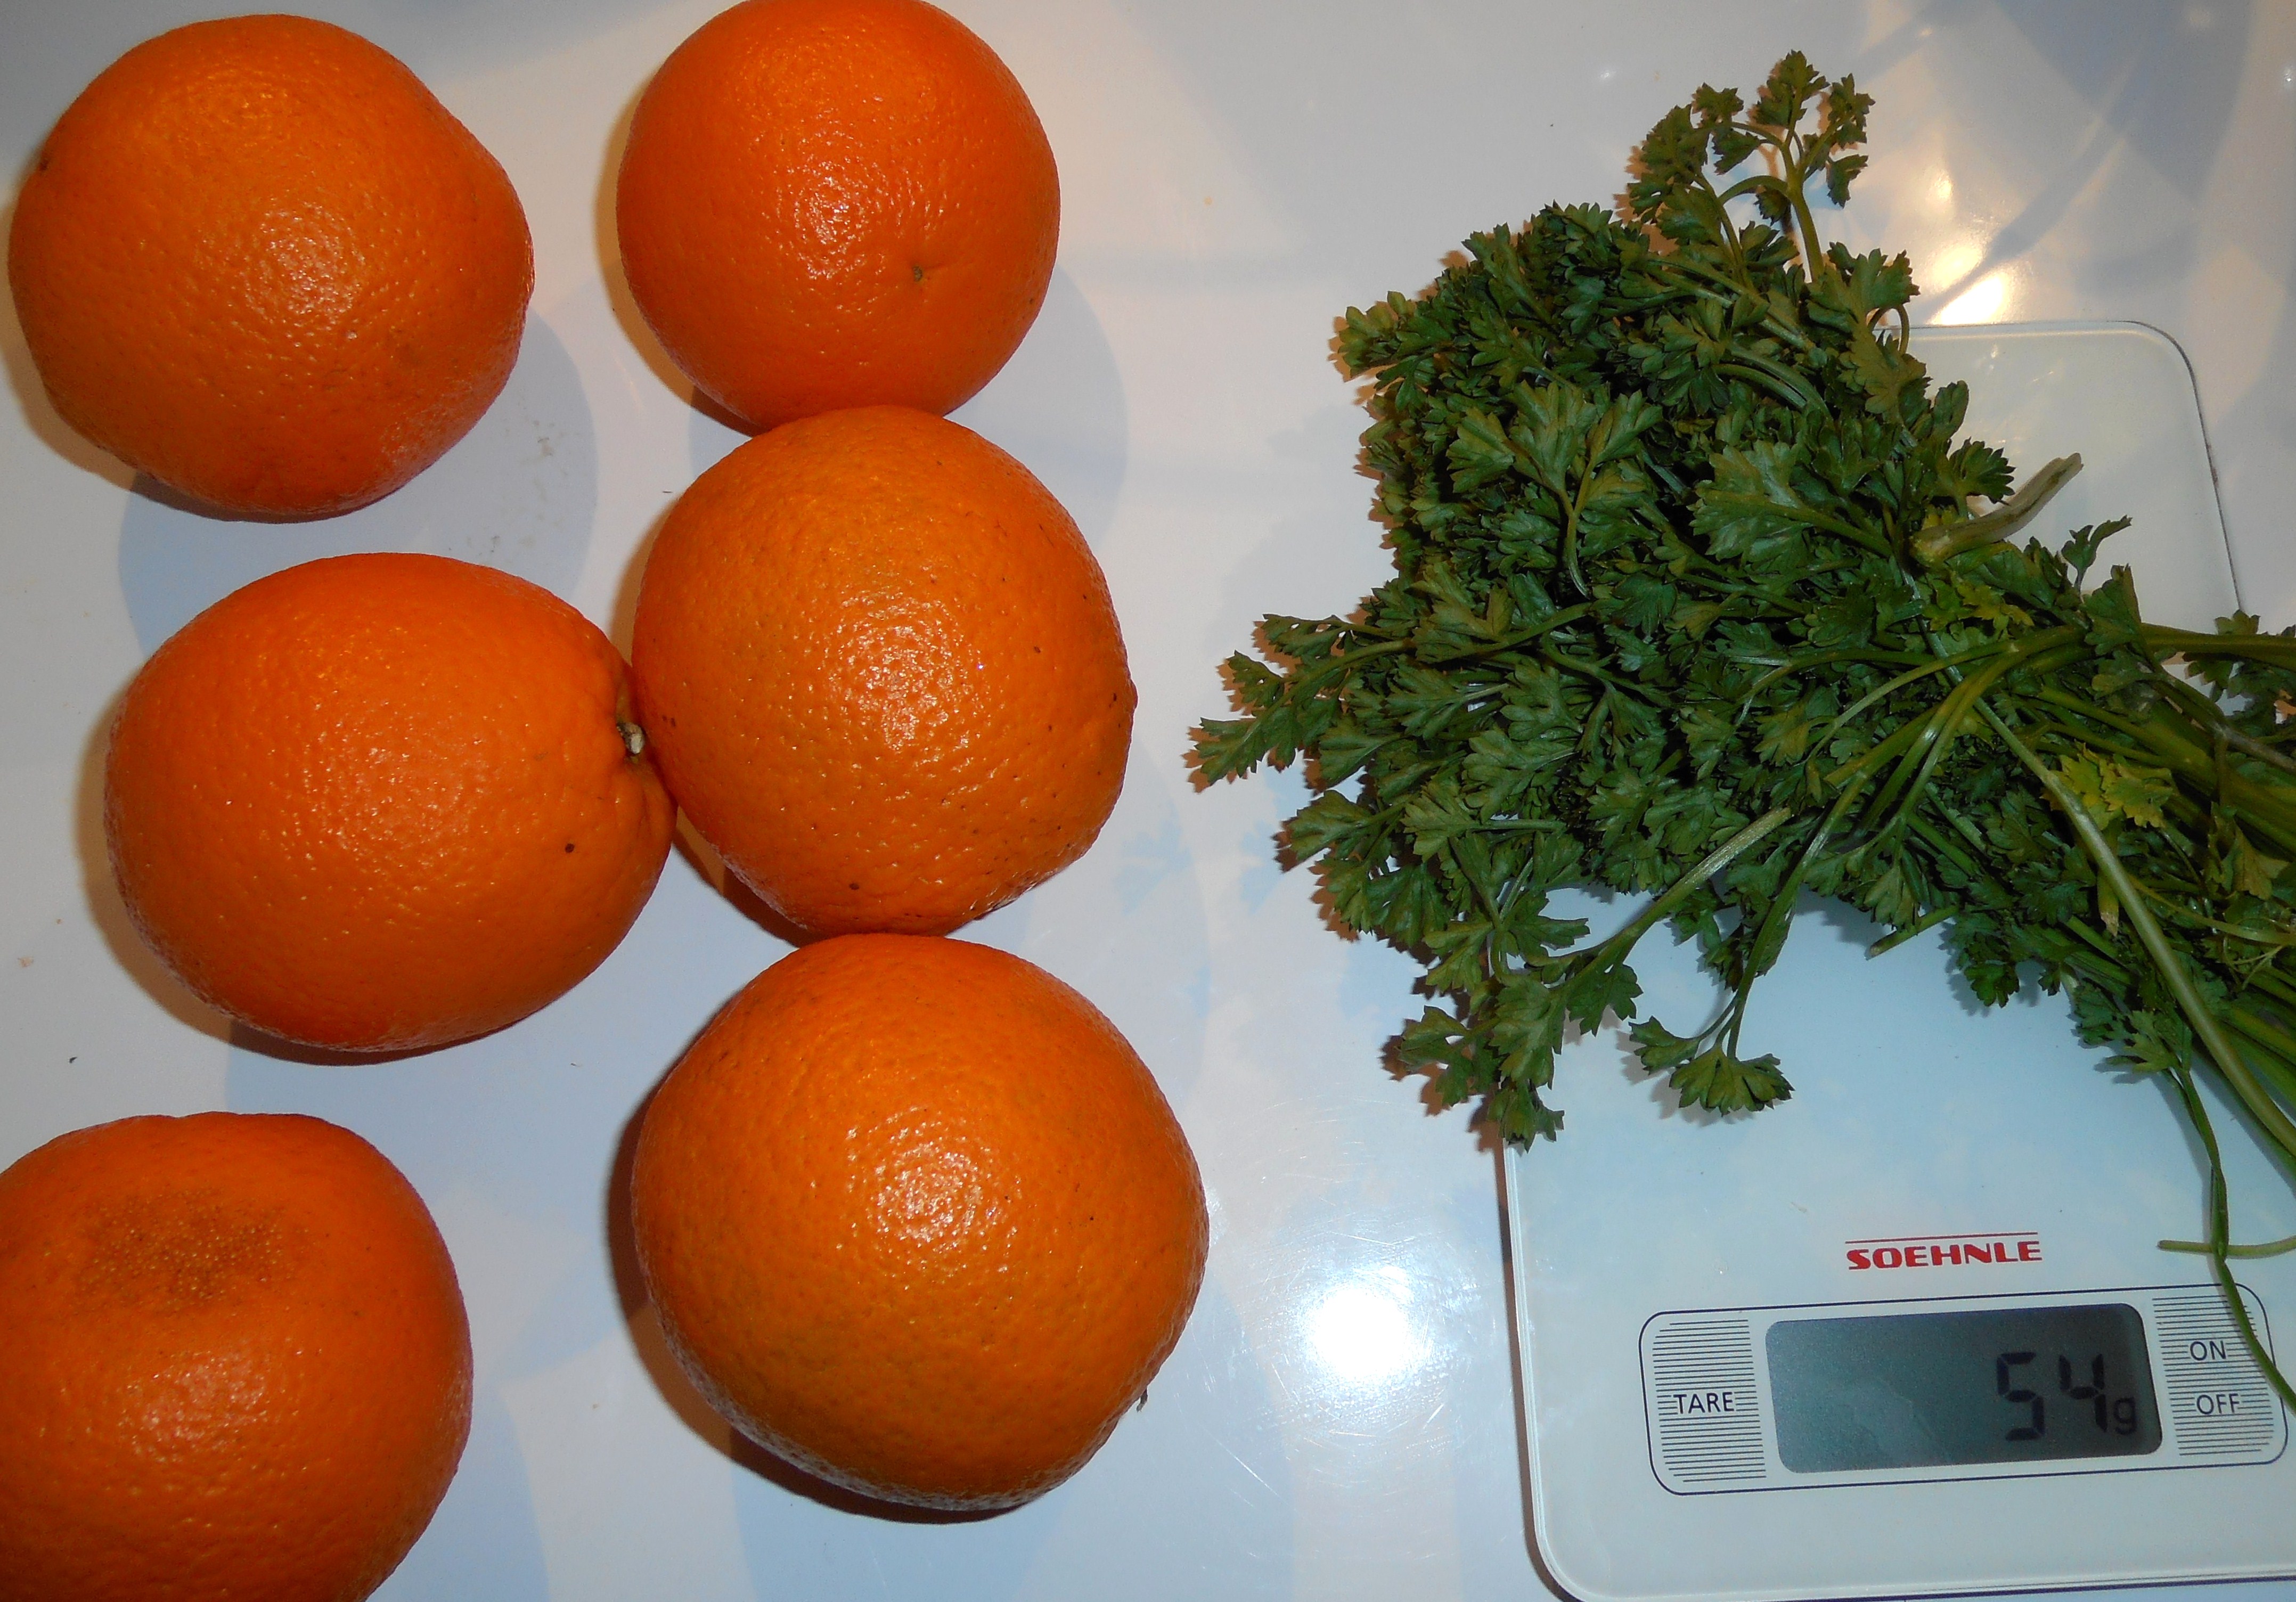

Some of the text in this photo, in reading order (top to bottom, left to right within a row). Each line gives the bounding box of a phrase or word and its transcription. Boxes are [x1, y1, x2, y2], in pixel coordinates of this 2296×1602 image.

[1846, 1240, 2042, 1270] SOEHNLE
[2189, 1340, 2227, 1361] ON
[1673, 1391, 1735, 1415] TARE
[2196, 1393, 2240, 1415] OFF
